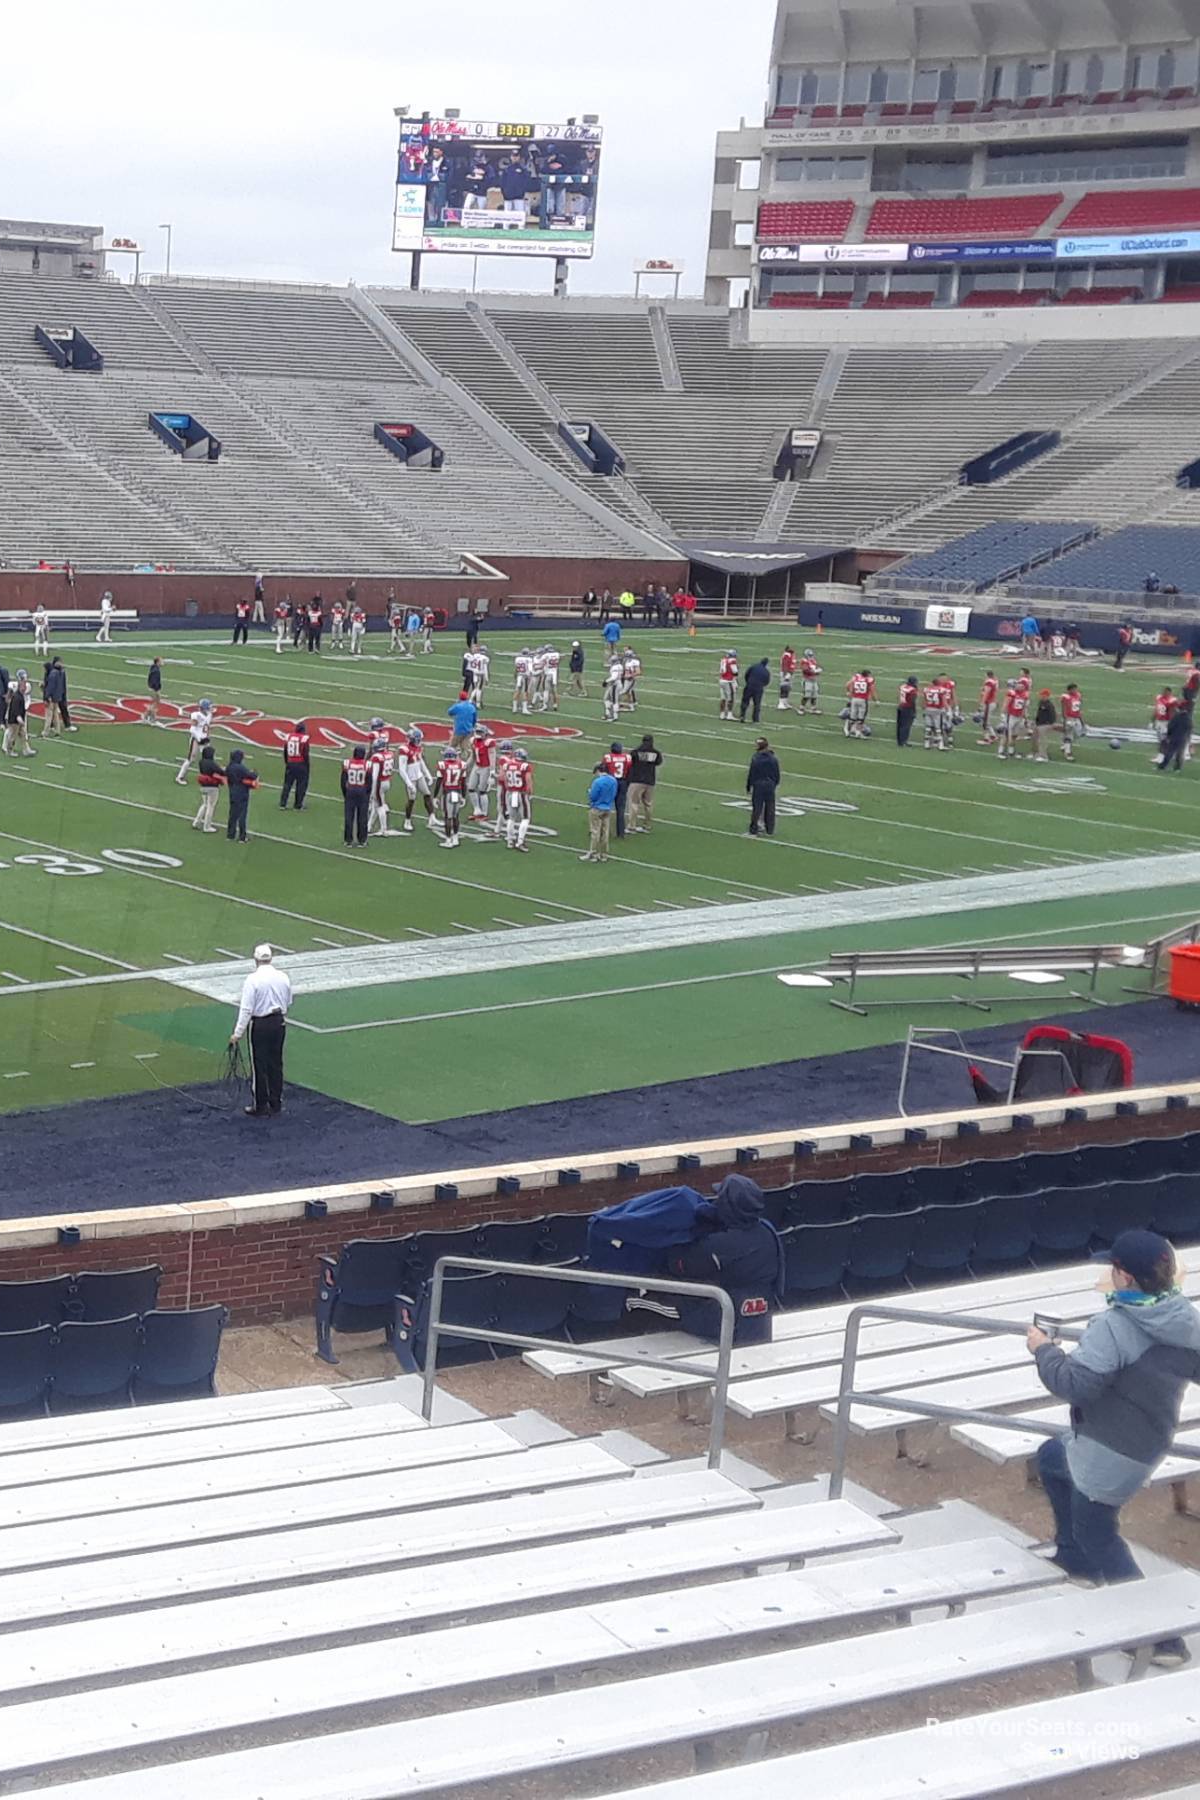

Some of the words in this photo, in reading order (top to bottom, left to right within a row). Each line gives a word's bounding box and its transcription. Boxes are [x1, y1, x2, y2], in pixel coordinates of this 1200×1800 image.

[475, 123, 483, 134] 0
[499, 124, 531, 136] 33:03
[564, 127, 580, 139] Ole
[580, 128, 599, 140] Miss
[760, 246, 776, 260] Ole
[775, 246, 798, 260] Miss
[861, 613, 901, 624] NISSAN
[1131, 627, 1179, 646] FedEx
[287, 743, 300, 757] 81
[347, 768, 366, 786] 80
[447, 769, 461, 785] 17
[614, 761, 624, 779] 3
[13, 848, 183, 876] 30
